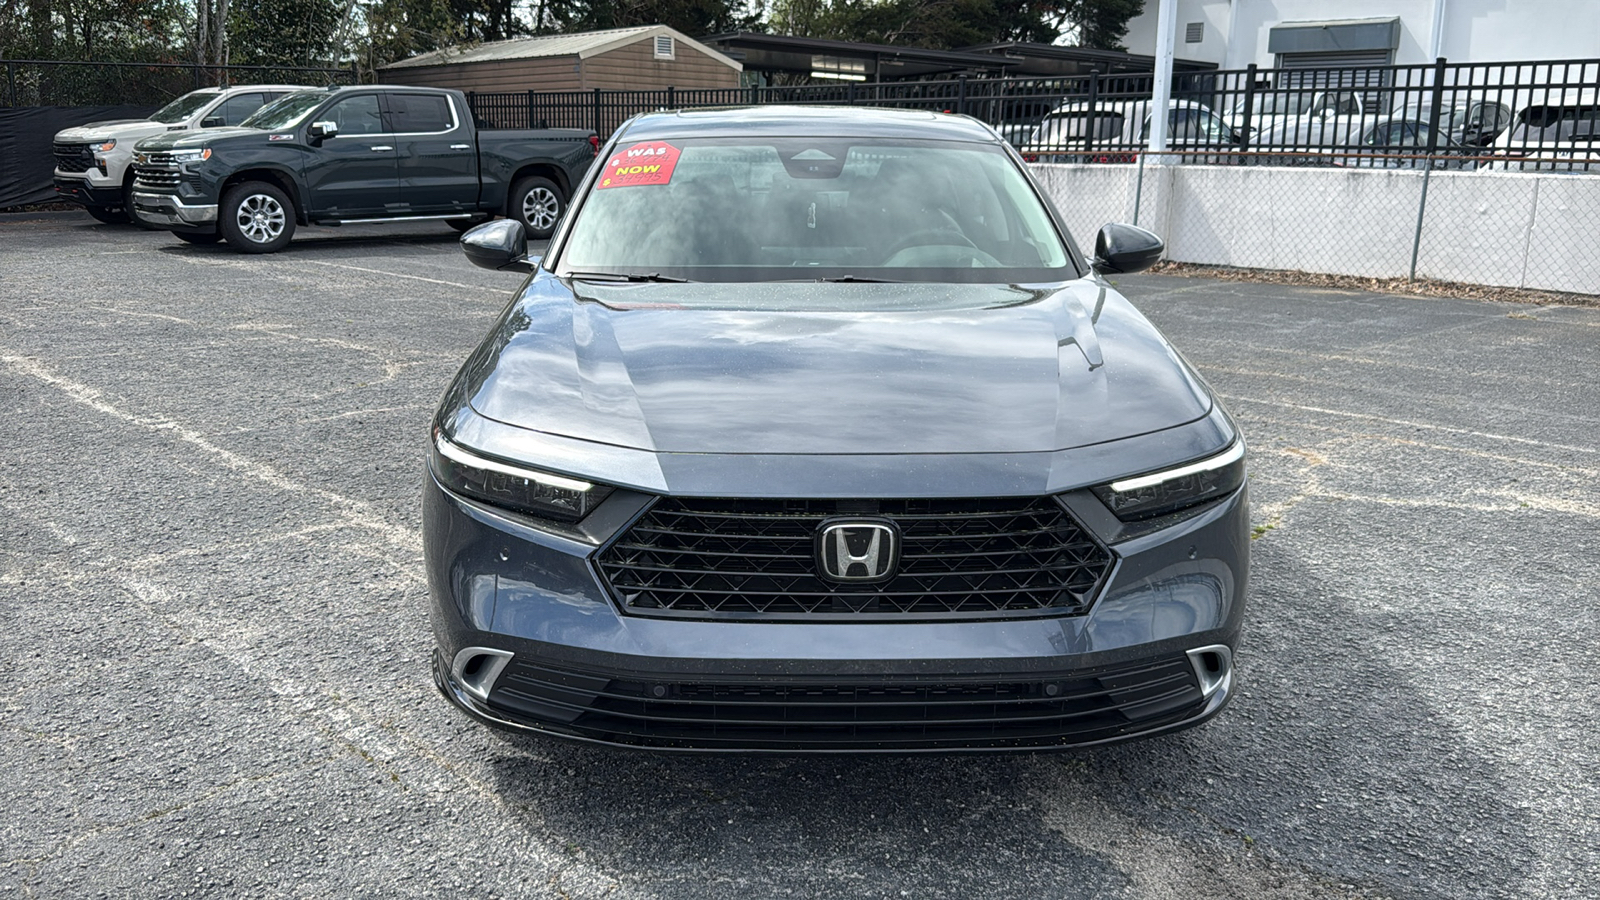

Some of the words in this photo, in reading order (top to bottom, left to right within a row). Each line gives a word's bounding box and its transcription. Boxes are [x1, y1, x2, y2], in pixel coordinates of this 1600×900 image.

[628, 147, 667, 157] WAS
[616, 165, 660, 176] NOW
[603, 178, 611, 186] $
